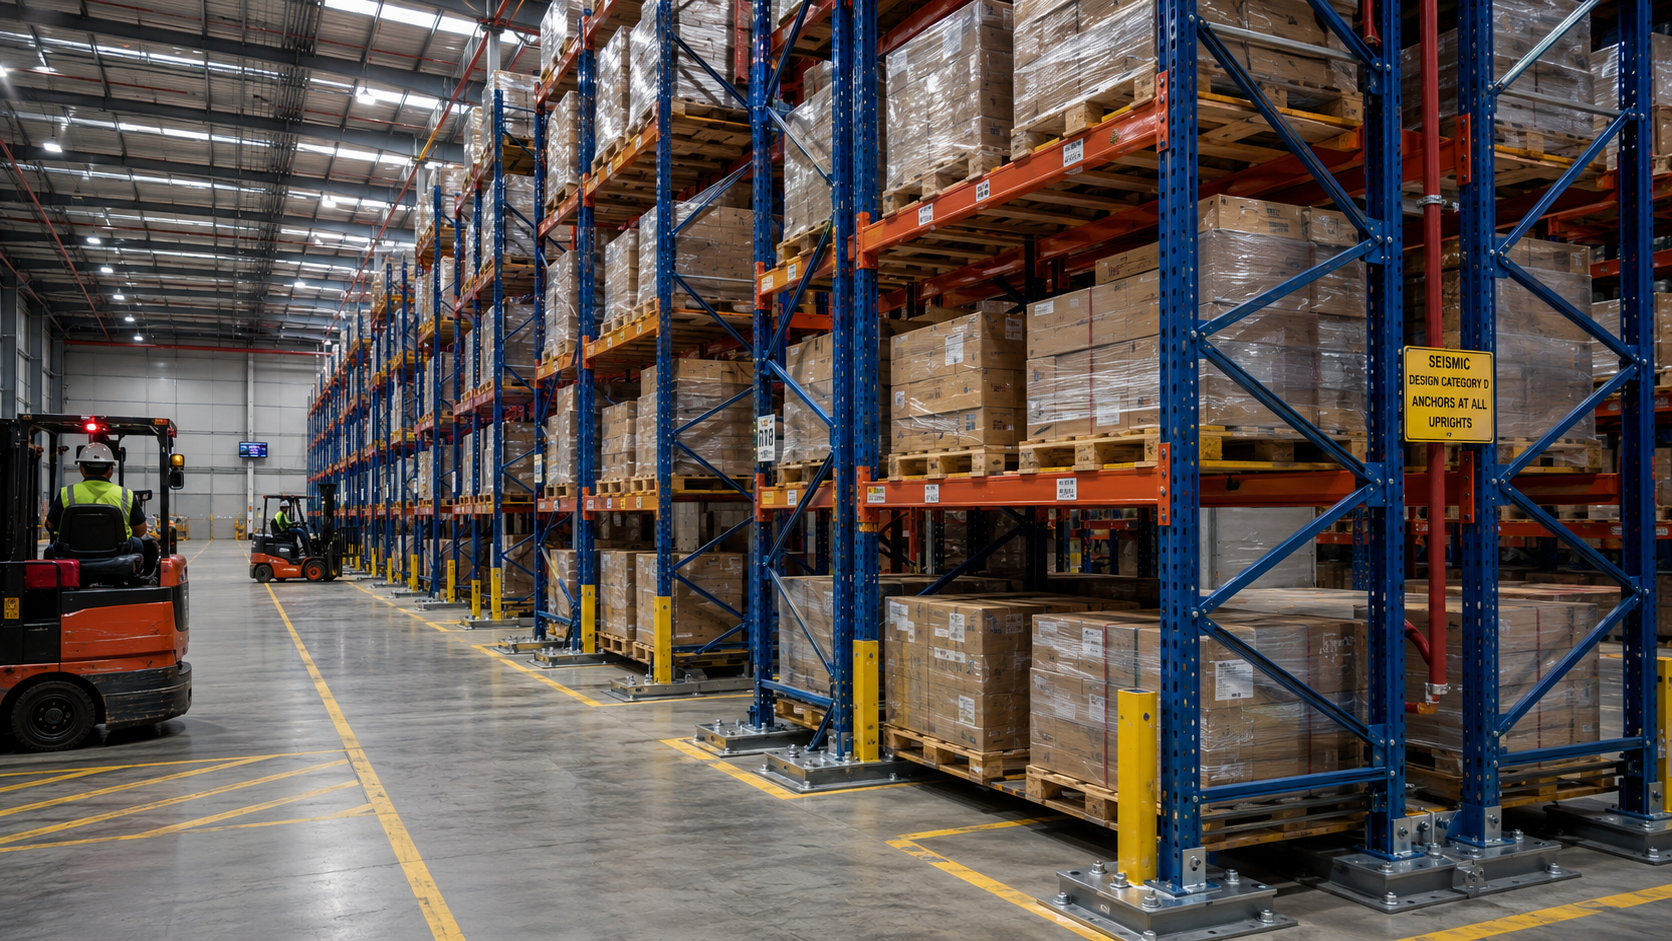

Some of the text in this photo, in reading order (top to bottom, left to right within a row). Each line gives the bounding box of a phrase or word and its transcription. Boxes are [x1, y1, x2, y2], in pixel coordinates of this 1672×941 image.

[1429, 355, 1470, 370] SEISMIC
[1409, 375, 1489, 389] DESIGN CATEGORY D
[1412, 396, 1487, 410] ANCHORS AT ALL
[1429, 416, 1473, 429] UPRIGHTS
